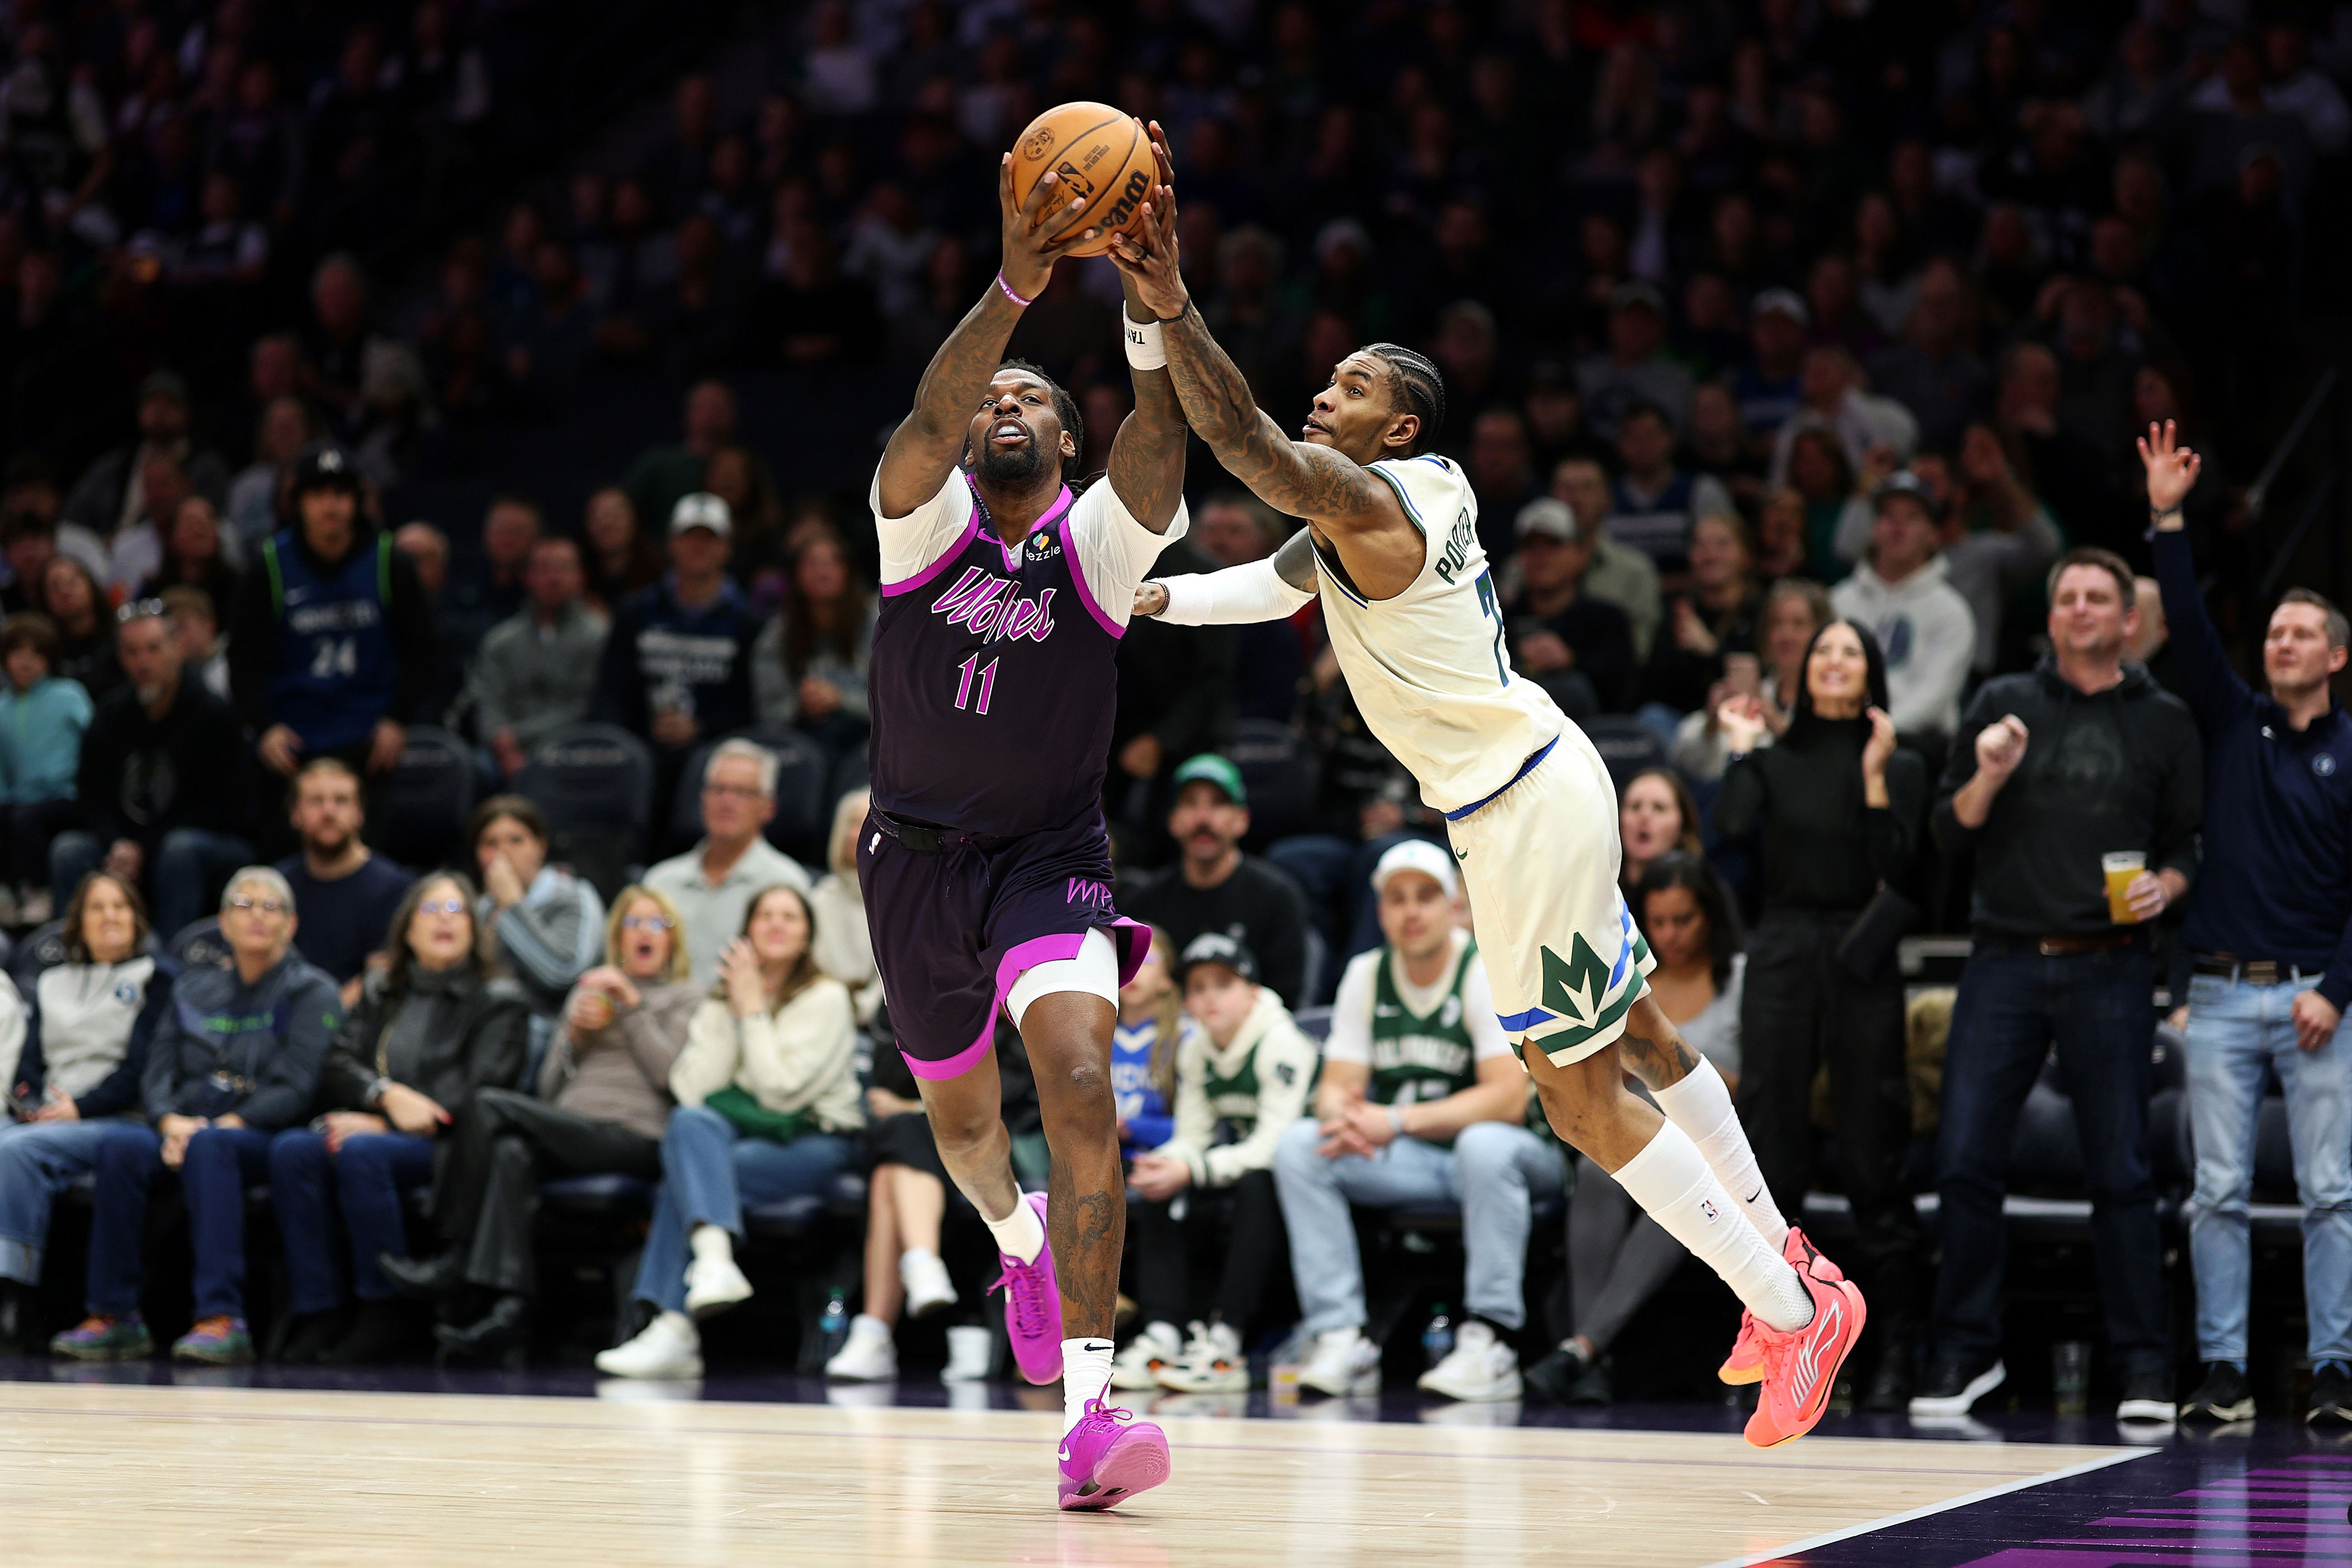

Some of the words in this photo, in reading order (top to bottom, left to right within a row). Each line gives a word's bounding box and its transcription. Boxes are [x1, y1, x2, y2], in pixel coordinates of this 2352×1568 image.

[1089, 169, 1150, 239] Wilso
[1026, 546, 1061, 561] sezzle
[1435, 507, 1475, 585] PORTER
[932, 566, 1057, 644] Wolves
[1475, 566, 1509, 687] 7
[955, 652, 999, 715] 11
